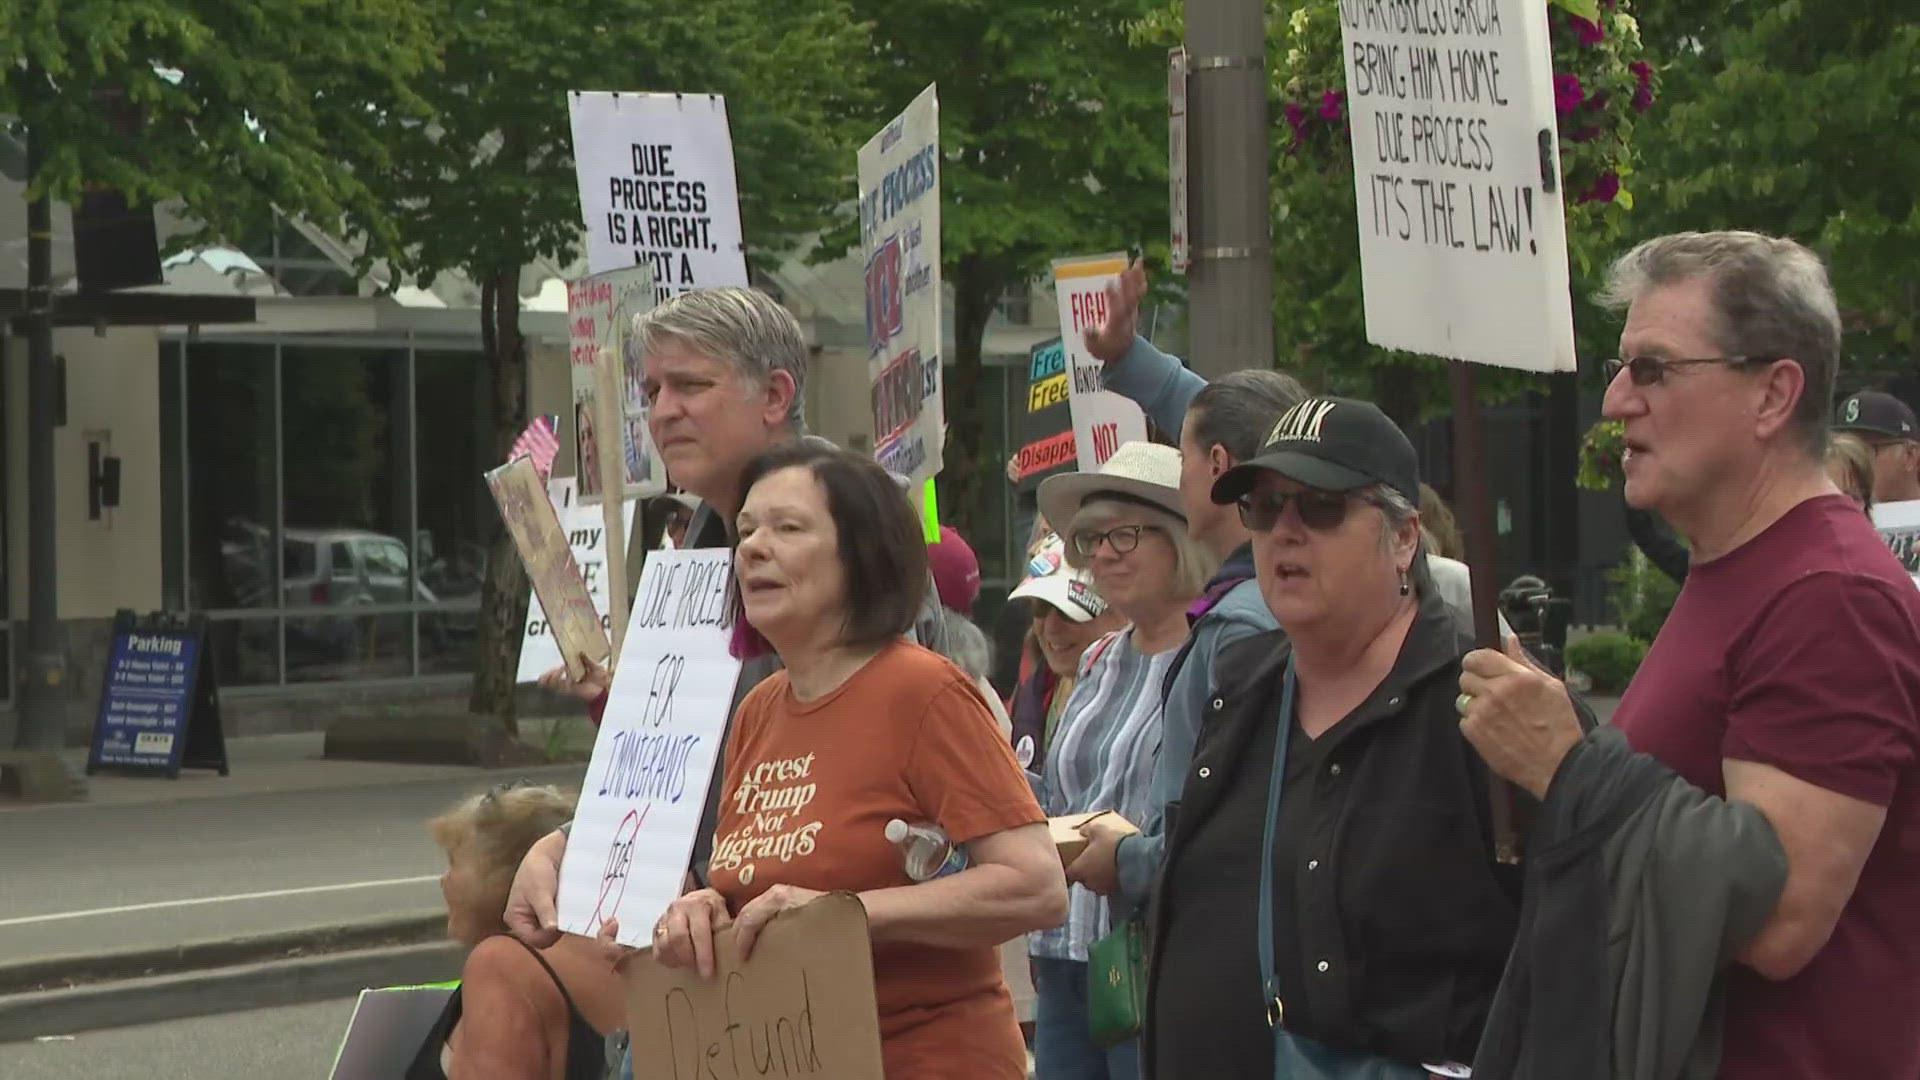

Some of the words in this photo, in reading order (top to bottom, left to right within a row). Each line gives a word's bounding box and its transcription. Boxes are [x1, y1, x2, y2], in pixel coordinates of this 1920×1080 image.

[1450, 0, 1502, 36] GARCIA
[1353, 42, 1406, 99] BRING
[1408, 45, 1445, 102] HIM
[1448, 48, 1508, 106] HOME
[632, 143, 674, 176] DUE
[1375, 111, 1409, 164] DUE
[1411, 114, 1494, 172] PROCESS
[610, 177, 707, 213] PROCESS
[607, 212, 627, 244] IS
[632, 215, 645, 246] A
[647, 216, 717, 253] RIGHT,
[1371, 174, 1411, 241] IT'S
[1411, 179, 1465, 248] THE
[1469, 183, 1537, 256] LAW!
[681, 252, 694, 284] A
[1071, 291, 1106, 335] FIGH
[1034, 348, 1065, 378] Fre
[1031, 380, 1069, 411] Free
[1092, 422, 1119, 465] NOT
[569, 527, 602, 550] my
[641, 562, 681, 629] DUE
[127, 634, 183, 656] Parking
[643, 653, 685, 728] FOR
[734, 783, 816, 816] Trump
[743, 811, 788, 837] Not
[665, 969, 822, 1080] Defund
